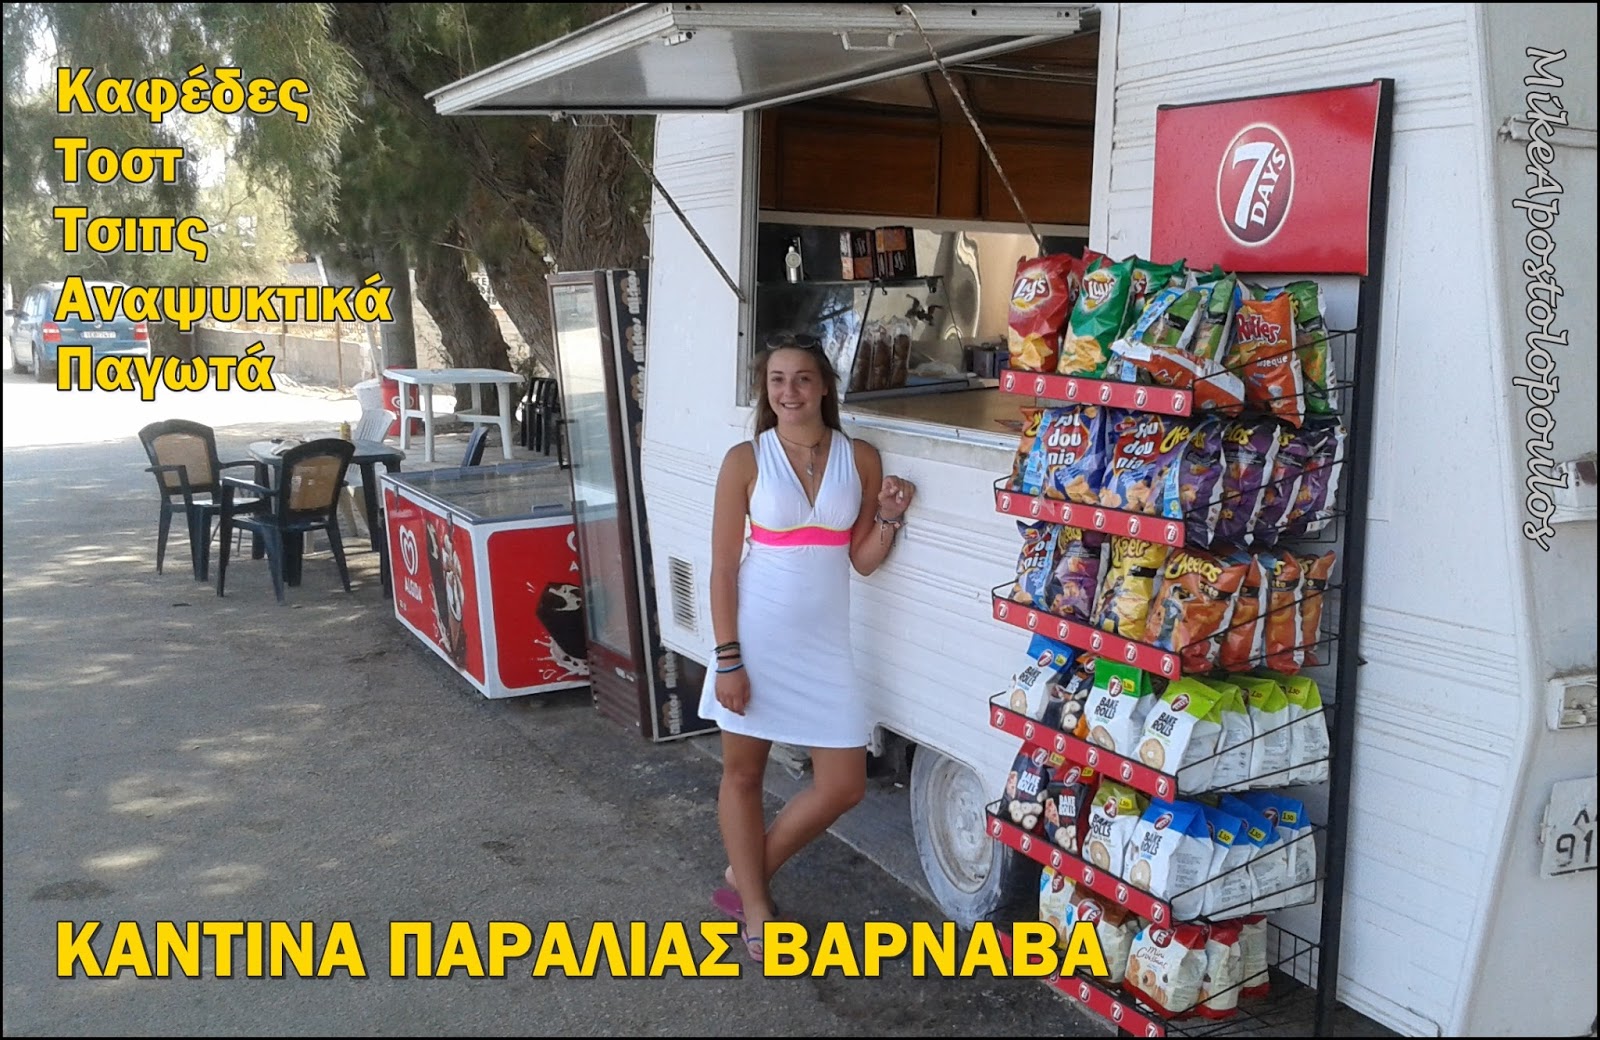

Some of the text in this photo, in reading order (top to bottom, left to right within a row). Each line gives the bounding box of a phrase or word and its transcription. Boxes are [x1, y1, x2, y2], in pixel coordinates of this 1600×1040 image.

[1232, 141, 1286, 230] 7 DAYS
[1236, 313, 1280, 345] Ruffles
[1047, 432, 1082, 447] dou
[1099, 697, 1119, 710] BAKE
[1094, 705, 1116, 720] ROLLS
[1158, 712, 1178, 726] BAKE
[1151, 719, 1174, 737] ROLLS
